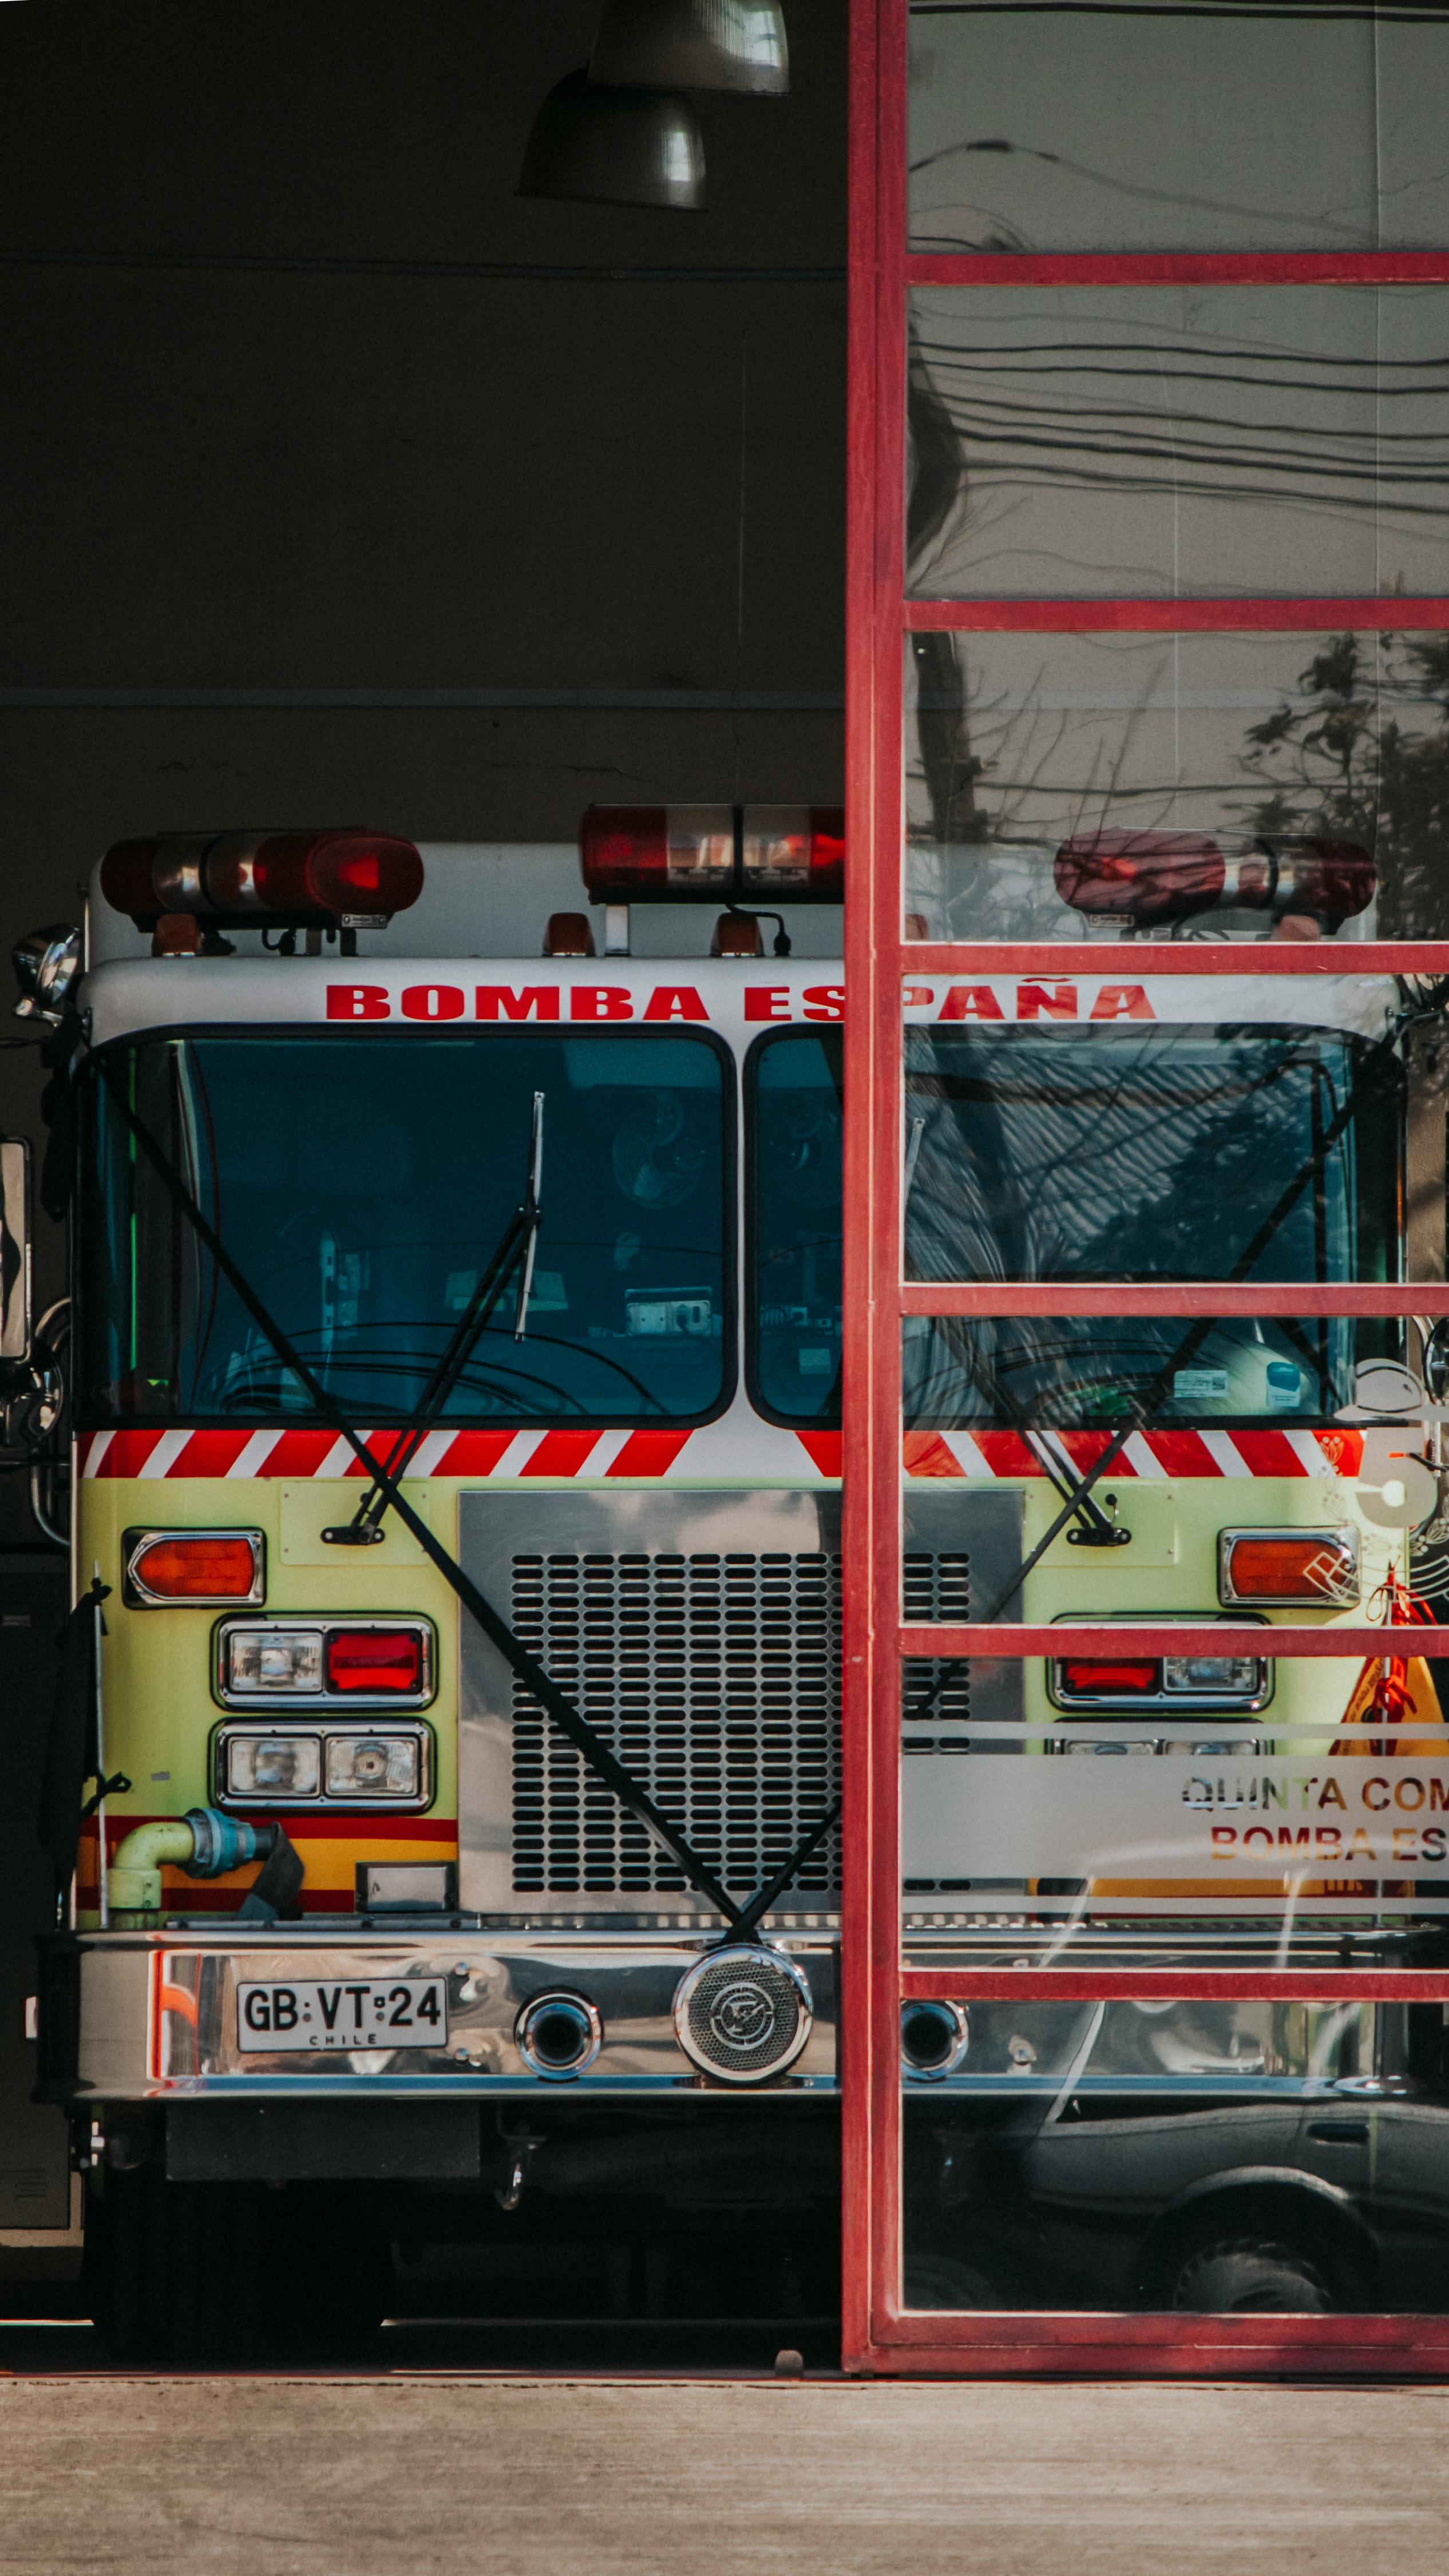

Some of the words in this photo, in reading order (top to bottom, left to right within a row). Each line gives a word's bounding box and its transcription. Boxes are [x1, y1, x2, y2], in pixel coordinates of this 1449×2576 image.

[326, 984, 710, 1021] BOMBA
[1182, 1776, 1348, 1813] QUINTA
[1210, 1826, 1377, 1861] BOMBA
[309, 2033, 377, 2046] CHILE
